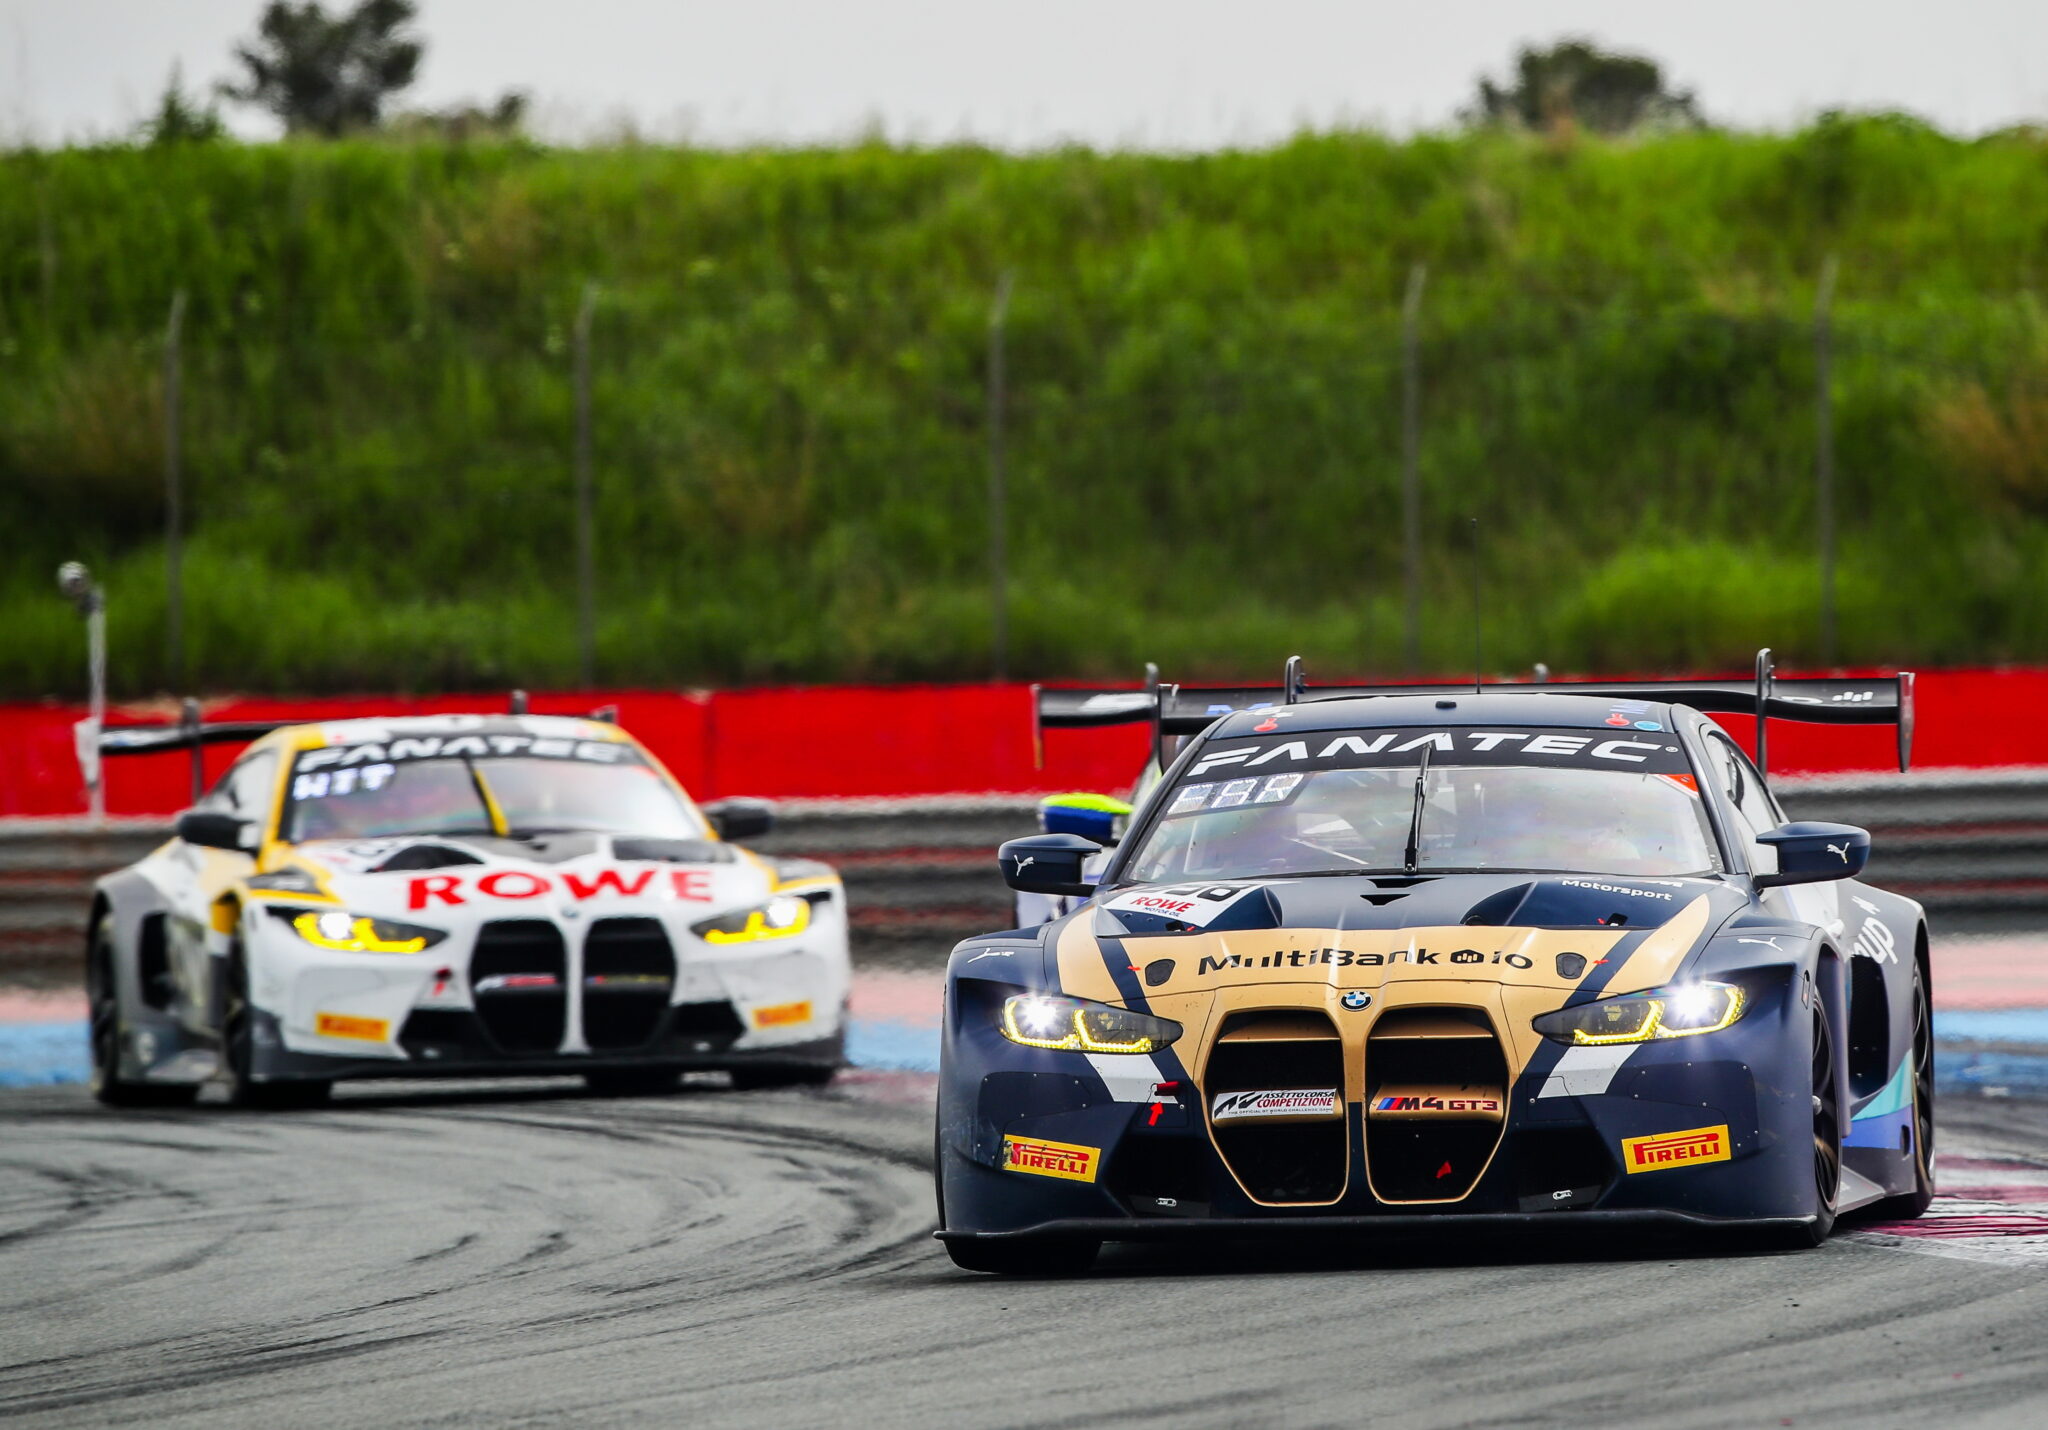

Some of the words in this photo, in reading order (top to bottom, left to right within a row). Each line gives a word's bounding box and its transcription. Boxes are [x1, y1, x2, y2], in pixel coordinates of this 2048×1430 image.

[1187, 731, 1663, 777] FANATEC
[407, 868, 714, 912] ROWE
[1562, 880, 1673, 901] Motorsport
[1130, 896, 1196, 913] ROWE
[1198, 948, 1440, 975] MultiBank
[1491, 950, 1534, 970] io
[1256, 1097, 1334, 1108] COMPETIZIONE
[1263, 1091, 1303, 1099] ASSETTO
[1448, 1100, 1498, 1111] GT3
[1011, 1143, 1090, 1175] PIRELLI
[1633, 1133, 1720, 1165] PIRELLI
